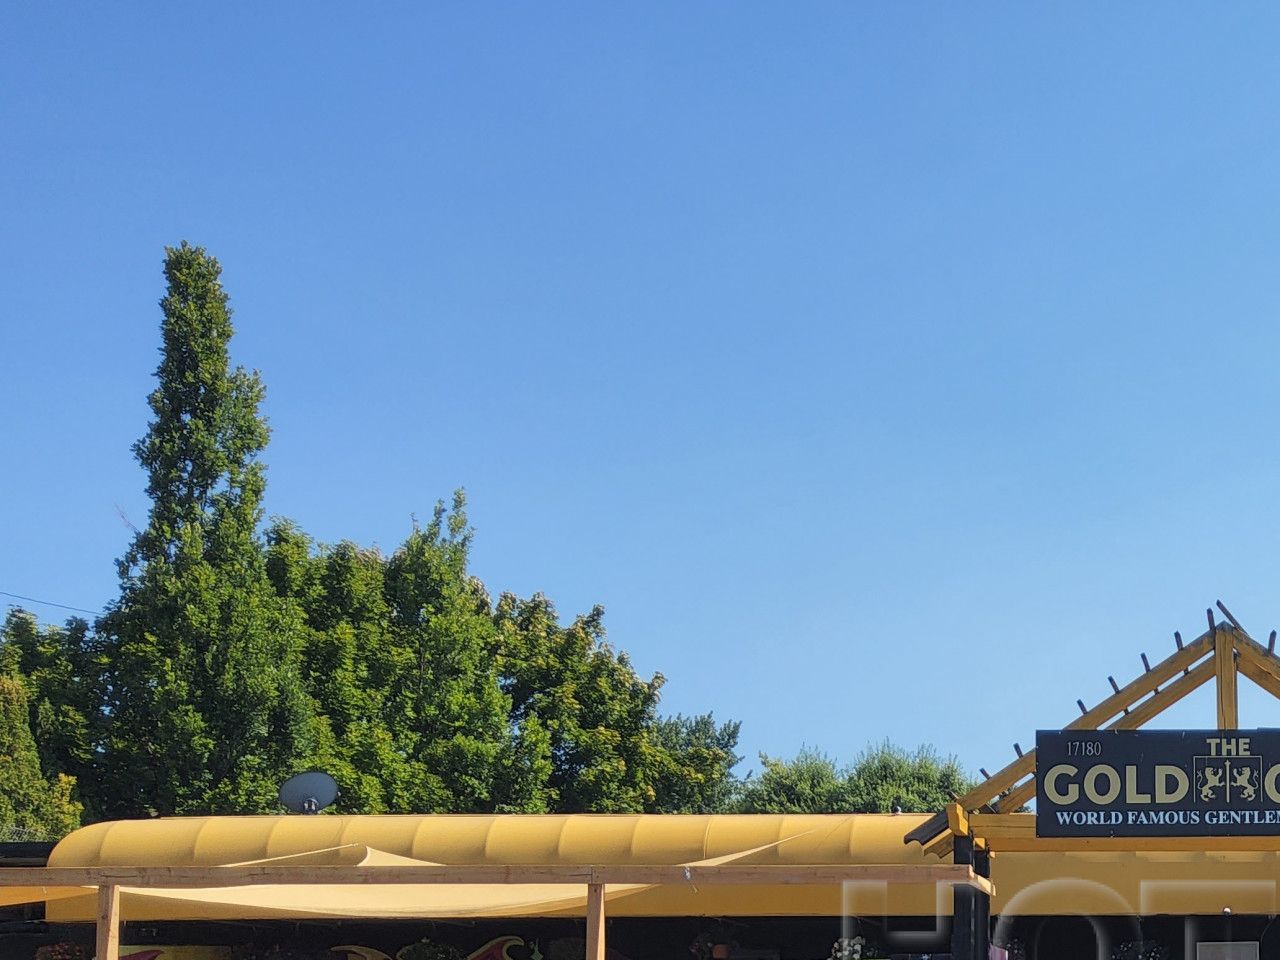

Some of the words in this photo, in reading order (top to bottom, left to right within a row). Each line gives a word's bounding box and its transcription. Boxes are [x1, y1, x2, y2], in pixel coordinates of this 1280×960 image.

[1067, 741, 1102, 756] 17180
[1206, 738, 1251, 756] THE
[1043, 764, 1190, 805] GOLD
[1056, 811, 1123, 826] WORLD
[1127, 810, 1200, 825] FAMOUS
